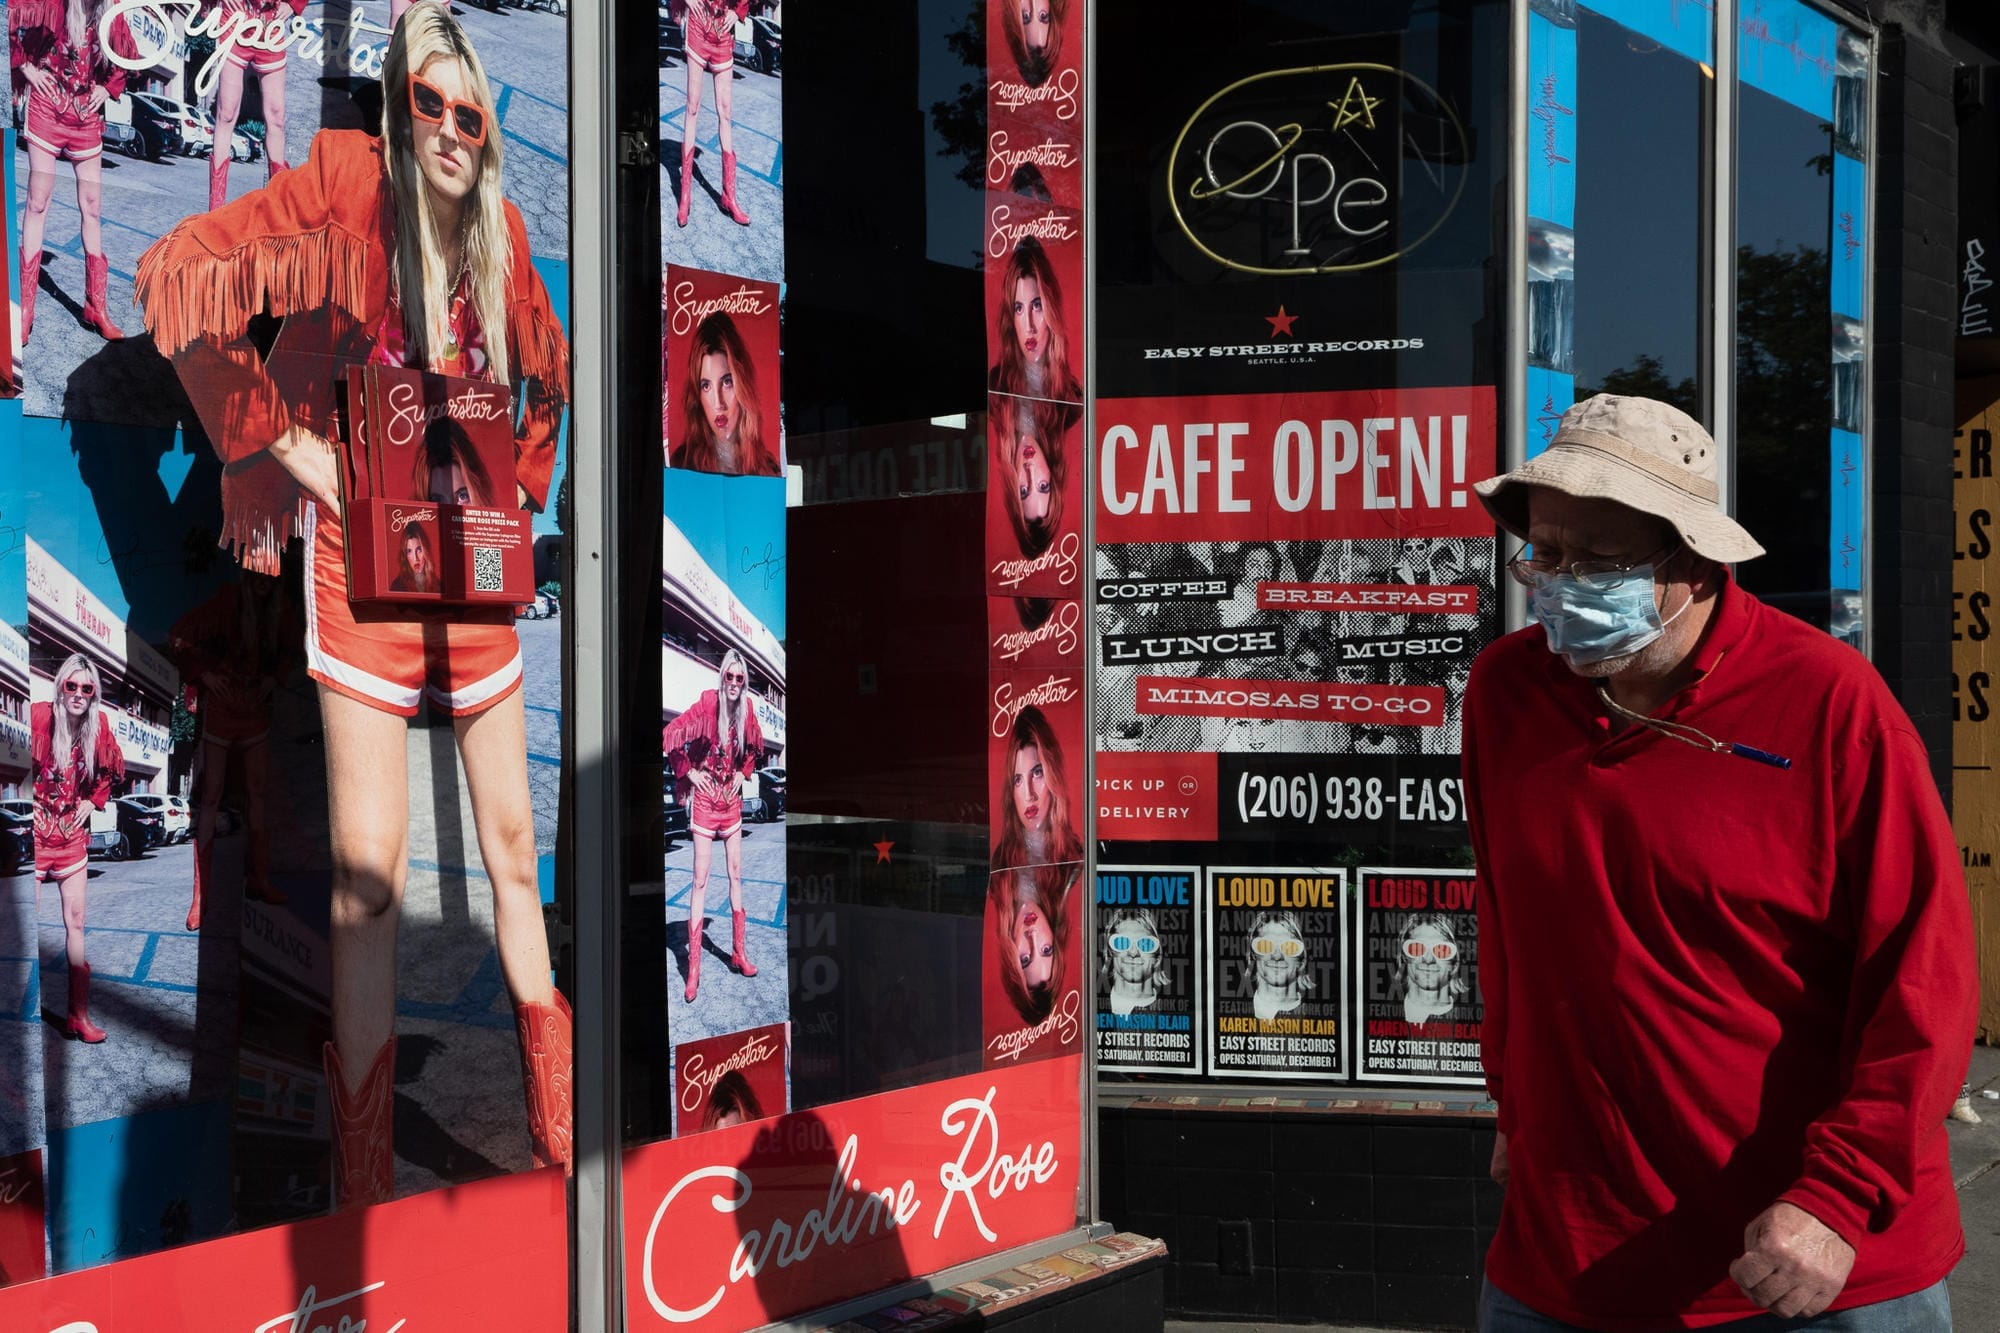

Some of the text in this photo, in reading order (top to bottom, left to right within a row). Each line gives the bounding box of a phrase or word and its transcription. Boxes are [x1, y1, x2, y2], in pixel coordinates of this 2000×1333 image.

[100, 0, 394, 97] upersta
[990, 69, 1079, 120] Superstar
[988, 131, 1078, 183] Superstar
[988, 205, 1078, 258] Superstar
[672, 281, 772, 336] Superstar
[1144, 338, 1424, 360] EASY STREET RECORDS
[388, 383, 504, 445] Superstar
[1100, 415, 1469, 516] CAFE OPEN!
[391, 508, 439, 532] Superstar
[451, 515, 477, 523] CAROLINE
[466, 509, 481, 517] ENTER
[991, 532, 1079, 590] Superstar
[1099, 580, 1228, 599] COFFEE
[1265, 588, 1468, 607] BREAKFAST
[993, 602, 1079, 661] Superstar
[1110, 632, 1276, 660] LUNCH
[1342, 637, 1463, 659] MUSIC
[992, 675, 1079, 738] Superstar
[1148, 687, 1432, 714] MIMOSAS TO-GO
[1143, 780, 1165, 791] UP
[1238, 772, 1317, 824] (206)
[1101, 807, 1190, 818] DELIVERY
[1960, 846, 1991, 867] 1AM
[1097, 877, 1189, 906] OUD LOVE
[1217, 877, 1335, 909] LOUD LOVE
[1368, 878, 1476, 911] LOUD LOV
[1219, 910, 1335, 934] A NOTEST
[1369, 912, 1380, 934] A
[1219, 936, 1335, 959] PHOPHY
[1219, 960, 1336, 1000] EXIT
[1178, 1000, 1190, 1012] OF
[1322, 1003, 1335, 1017] OF
[1475, 1007, 1483, 1020] O
[988, 989, 1080, 1061] Superstar
[1116, 1013, 1157, 1030] MASON
[1158, 1014, 1190, 1031] BLAIR
[1219, 1016, 1336, 1036] KAREN MASON BLAIR
[1368, 1020, 1408, 1036] KAREN
[1455, 1023, 1480, 1039] BLAI
[1105, 1032, 1142, 1047] STREET
[1144, 1033, 1190, 1049] RECORDS
[1219, 1036, 1336, 1054] EASY STREET RECORDS
[1368, 1039, 1481, 1057] EASY STREET RECORD
[1145, 1050, 1186, 1063] DECEMBER
[1219, 1053, 1246, 1065] OPENS
[1289, 1055, 1331, 1068] DECEMBER
[1368, 1056, 1395, 1069] OPENS
[681, 1035, 779, 1112] Superstar
[642, 1086, 1059, 1323] Caroline Rose
